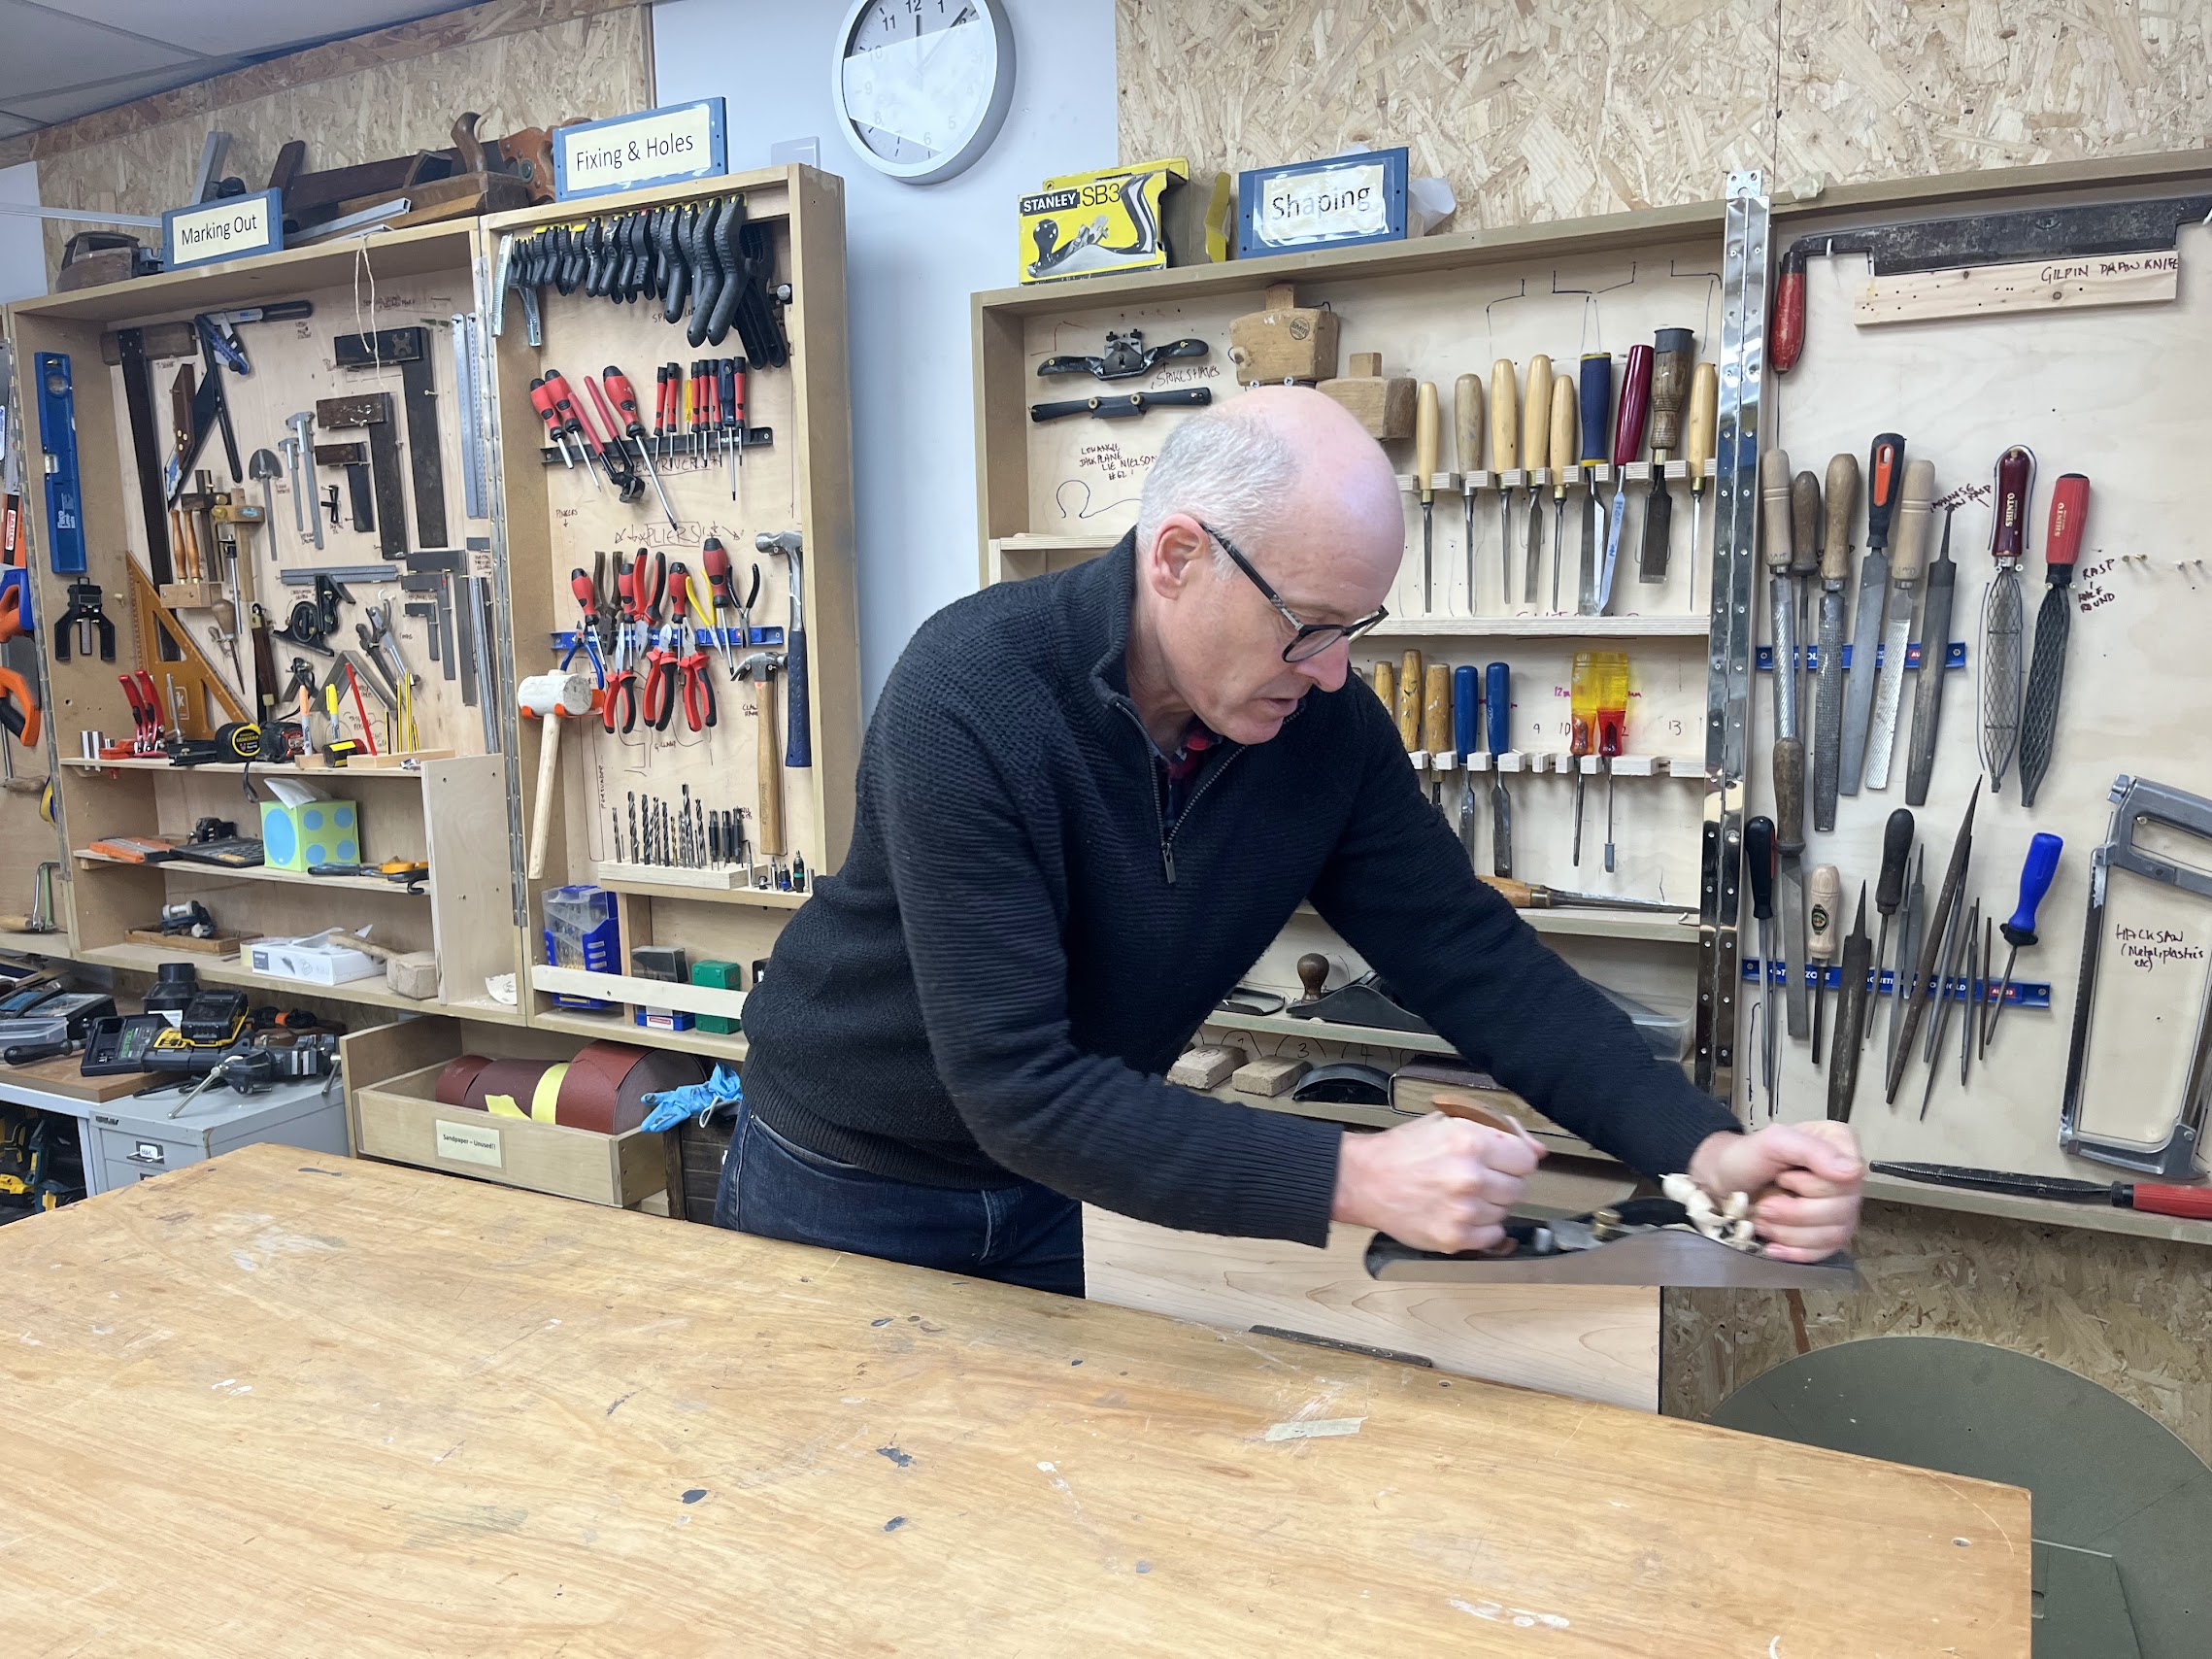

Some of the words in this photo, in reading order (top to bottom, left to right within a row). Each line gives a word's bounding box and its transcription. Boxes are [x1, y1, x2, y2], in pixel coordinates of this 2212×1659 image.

[905, 0, 922, 14] 12
[937, 0, 945, 14] 1
[882, 15, 896, 31] 11
[576, 148, 622, 172] Fixing
[627, 140, 641, 161] &
[647, 132, 693, 158] Holes
[1022, 192, 1077, 213] STANLEY
[1082, 183, 1122, 207] SB3
[1272, 187, 1371, 220] Shaping
[182, 221, 231, 246] Marking
[234, 214, 257, 233] Out
[2041, 264, 2089, 285] GILPIN
[2100, 261, 2140, 276] DRAW
[2144, 257, 2179, 271] KNIFE
[2004, 492, 2016, 527] SHINTO
[2054, 502, 2065, 538] SHINTO
[2083, 559, 2115, 580] RASP
[1668, 720, 1683, 736] 13
[2115, 924, 2184, 944] HACKSAW
[119, 1029, 136, 1059] FESTOOL
[1297, 1042, 1310, 1059] 3
[443, 1134, 469, 1145] Sandpaper
